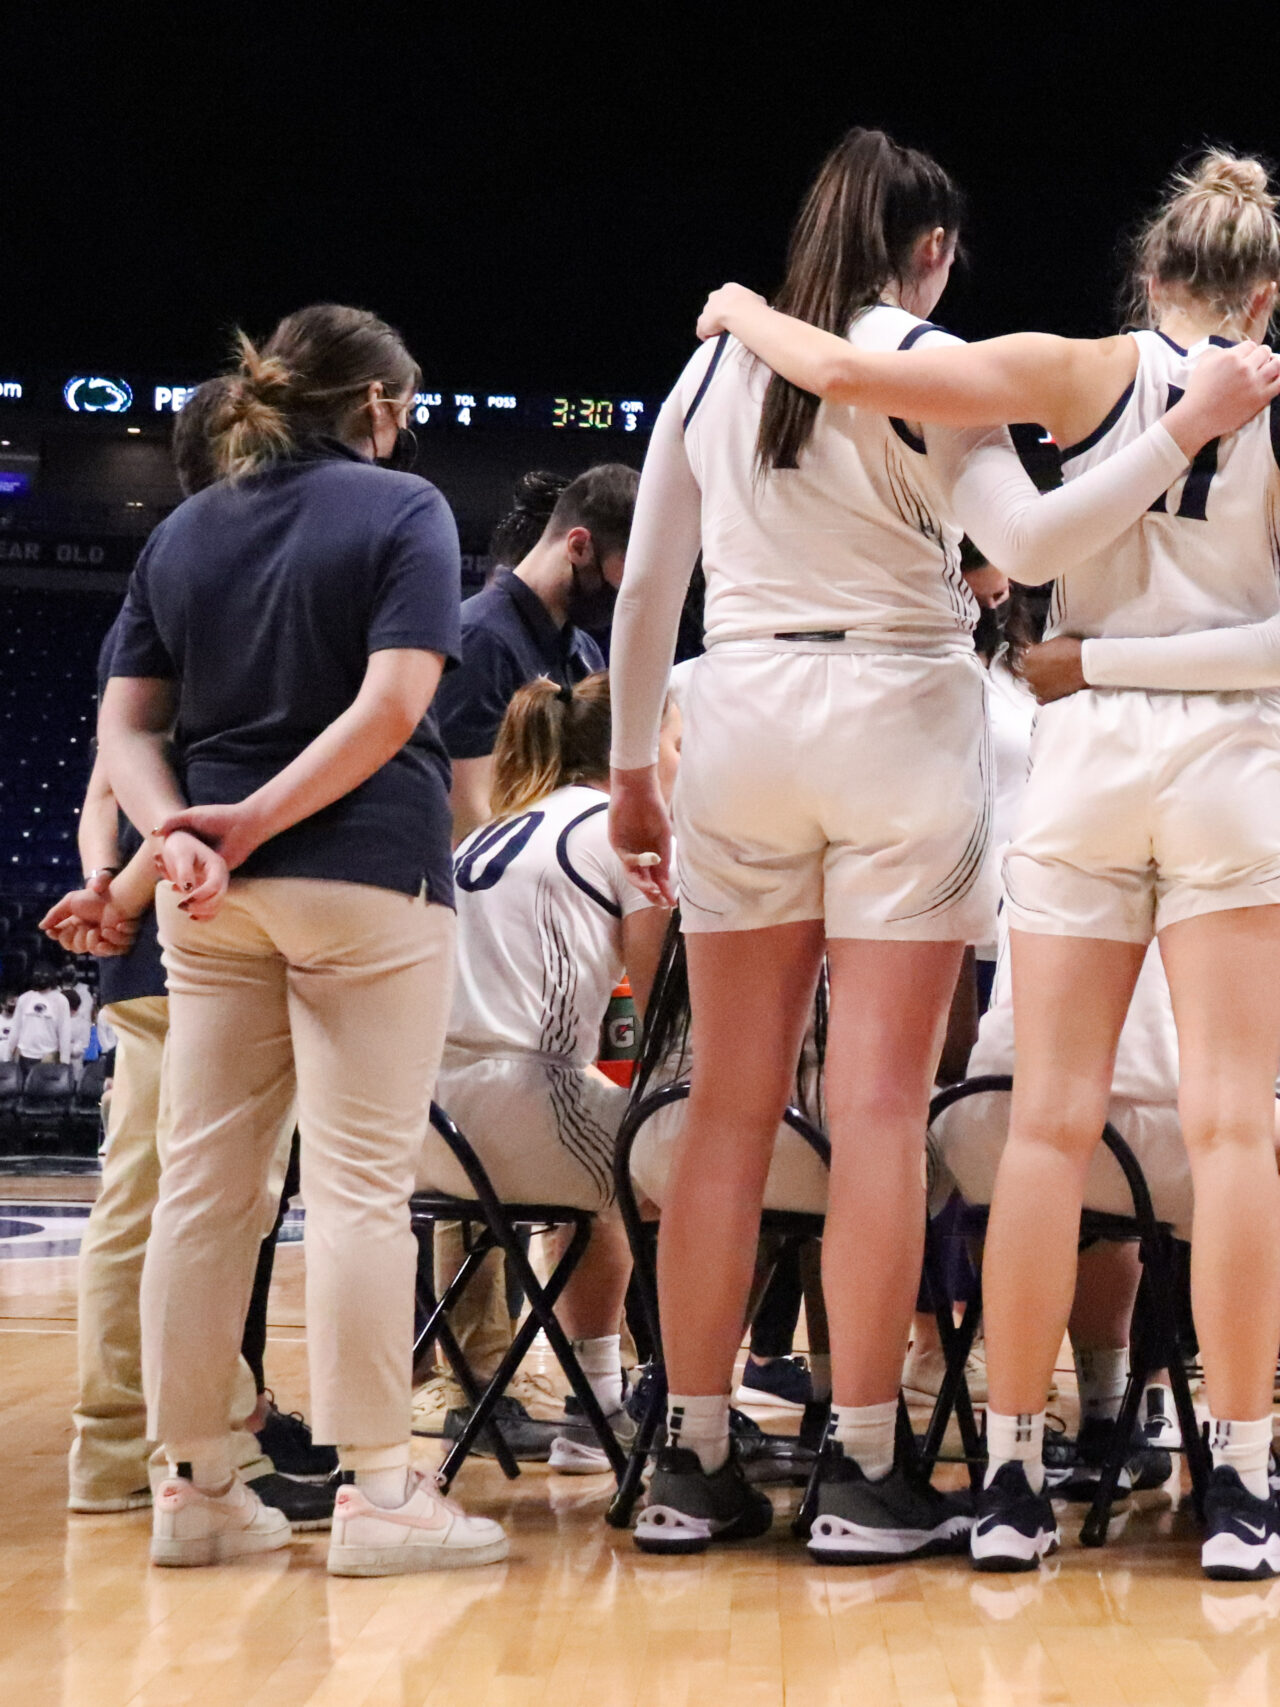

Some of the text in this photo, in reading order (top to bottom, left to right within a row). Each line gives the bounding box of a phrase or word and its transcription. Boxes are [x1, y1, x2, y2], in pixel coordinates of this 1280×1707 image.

[154, 386, 193, 411] PE
[414, 393, 441, 406] OULS
[488, 396, 516, 408] POSS
[416, 406, 471, 425] 0 4
[553, 398, 613, 428] 3:30
[625, 413, 637, 431] 3
[56, 545, 104, 563] OLD
[609, 1017, 635, 1048] G
